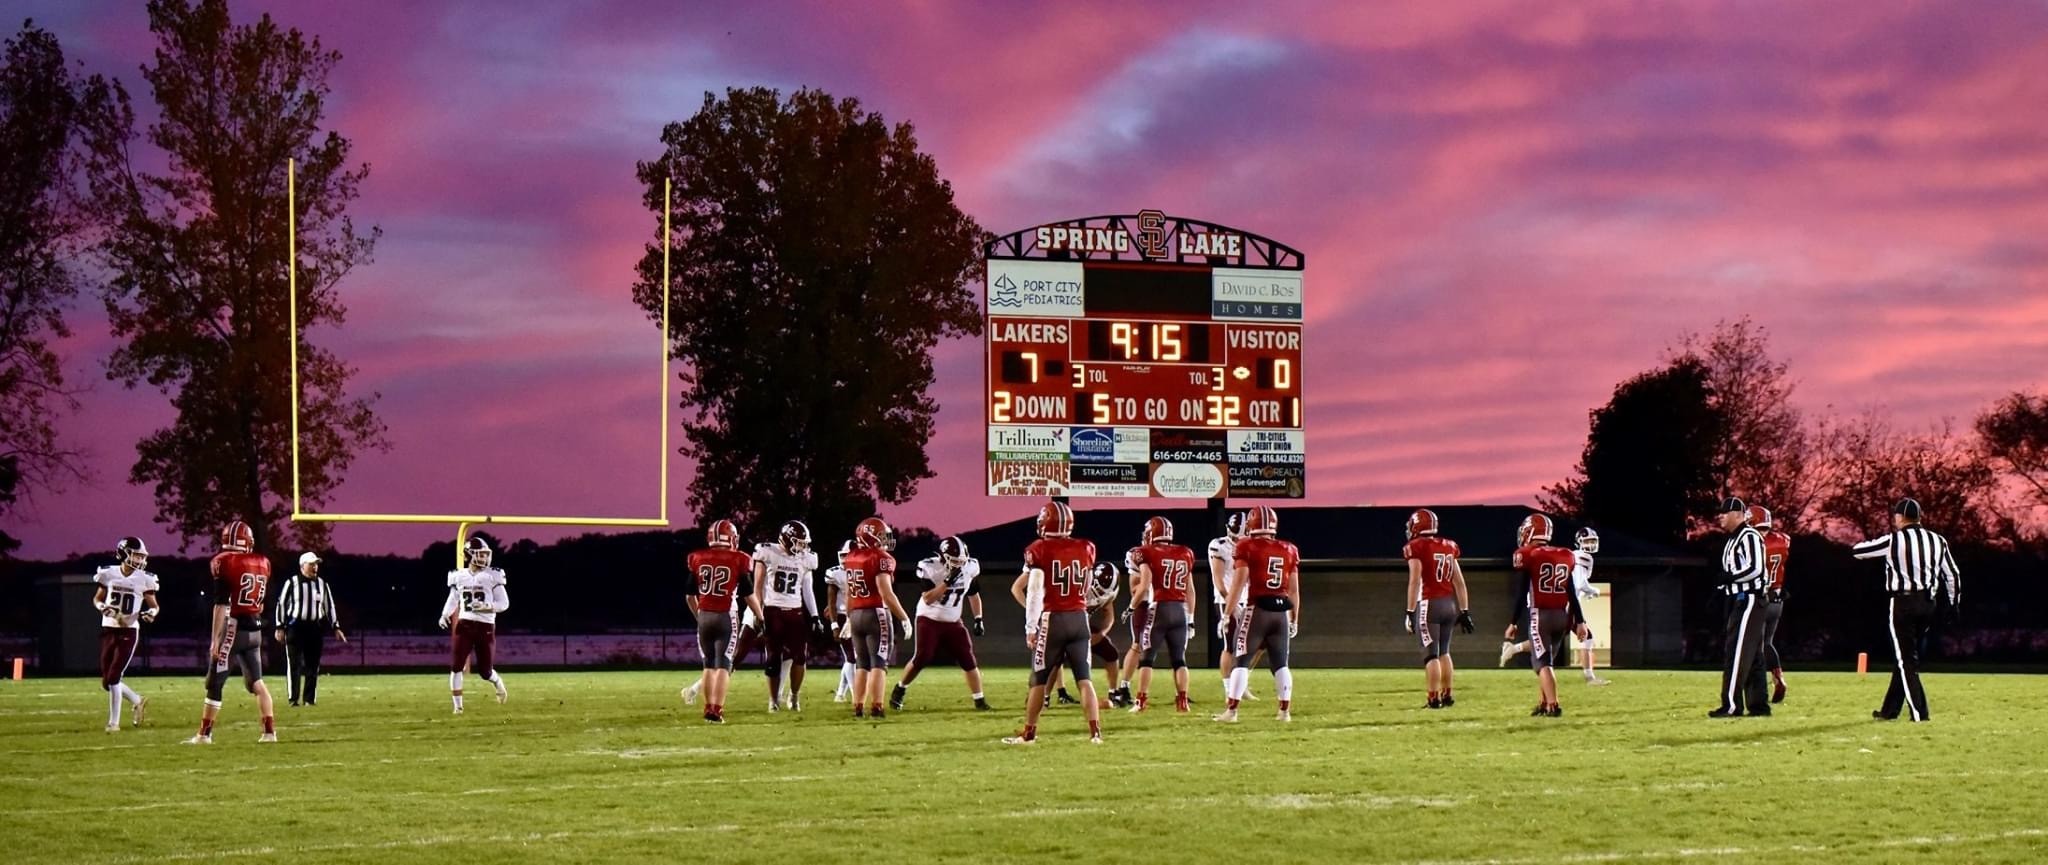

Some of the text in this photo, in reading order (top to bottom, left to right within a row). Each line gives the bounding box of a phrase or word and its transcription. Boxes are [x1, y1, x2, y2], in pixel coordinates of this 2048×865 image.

[1037, 227, 1241, 256] SPRING LAKE
[1023, 280, 1081, 294] PORT CITY
[1023, 294, 1083, 306] PEDIATRICS
[1222, 303, 1294, 316] HOMES
[992, 323, 1068, 345] LAKERS
[1111, 323, 1181, 361] 9:15
[1228, 329, 1299, 350] VISITOR
[1021, 352, 1038, 383] 7
[1072, 364, 1085, 388] 3
[1089, 369, 1108, 383] TOL
[1189, 372, 1208, 386] TOL
[1212, 367, 1225, 391] 3
[1274, 359, 1291, 389] 0
[993, 391, 1011, 422] 2
[1015, 396, 1067, 419] DOWN
[1092, 393, 1110, 423] 5
[1114, 399, 1203, 421] TO GO ON
[1206, 395, 1240, 426] 32
[1249, 400, 1280, 424] QTR
[1293, 397, 1299, 427] 1
[995, 429, 1055, 446] Trillium
[1072, 437, 1112, 446] Shoreline
[1251, 442, 1292, 451] CREDIT UNION
[1256, 432, 1287, 441] TRI-CITIES
[1153, 451, 1222, 461] 616-607-4465
[991, 461, 1070, 489] WESTSHORE
[1082, 468, 1137, 477] STRAIGHT LINE
[1160, 475, 1216, 489] Orchard Markets
[1229, 467, 1304, 477] CLARITY REALTY
[1230, 478, 1246, 486] Julie
[998, 487, 1028, 495] HEATING
[1031, 487, 1046, 495] AND
[699, 565, 730, 597] 32
[773, 571, 799, 595] 62
[1052, 560, 1088, 596] 44
[1161, 559, 1189, 590] 72
[1266, 556, 1284, 589] 5
[1539, 563, 1569, 593] 22
[238, 572, 267, 608] 27
[110, 591, 136, 615] 20
